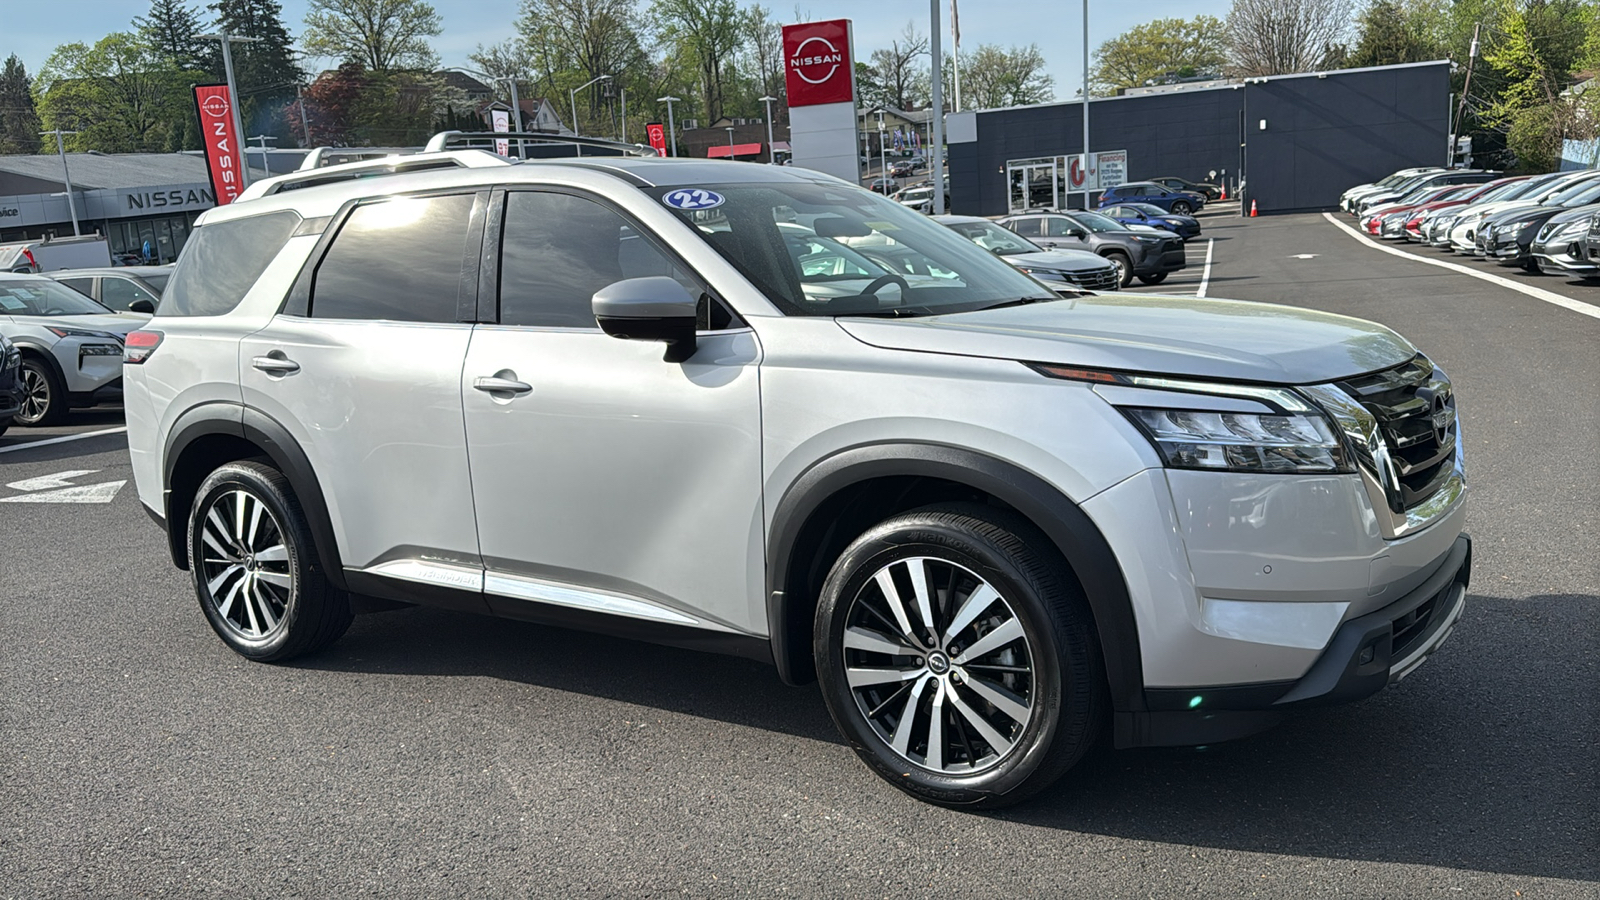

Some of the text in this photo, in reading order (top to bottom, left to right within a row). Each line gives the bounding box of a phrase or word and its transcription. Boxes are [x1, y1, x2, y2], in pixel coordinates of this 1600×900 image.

[790, 53, 842, 67] NISSAN
[213, 122, 238, 204] NISSAN
[127, 189, 214, 209] NISSAN
[673, 189, 717, 208] 22
